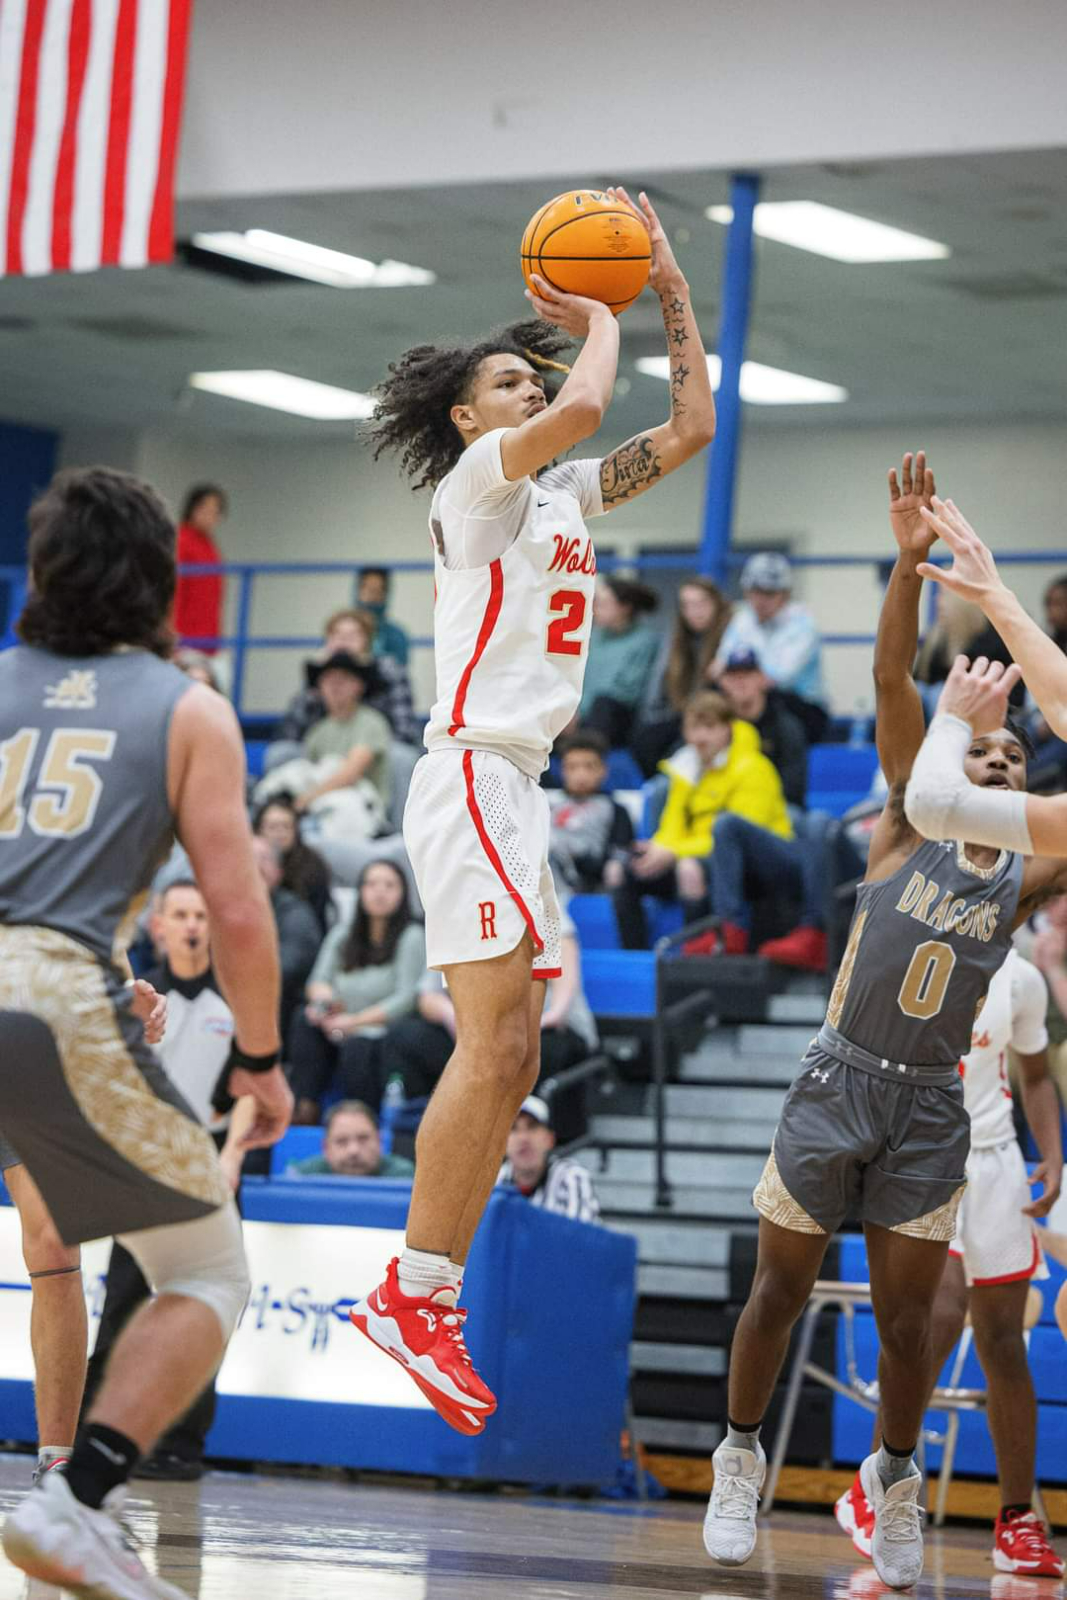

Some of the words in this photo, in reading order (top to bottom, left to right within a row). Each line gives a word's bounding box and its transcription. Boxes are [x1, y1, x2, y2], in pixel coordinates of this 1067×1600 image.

[546, 589, 586, 656] 2
[0, 727, 117, 840] 15
[478, 901, 498, 940] R
[895, 870, 1000, 942] DRAGONS
[897, 940, 957, 1020] 0
